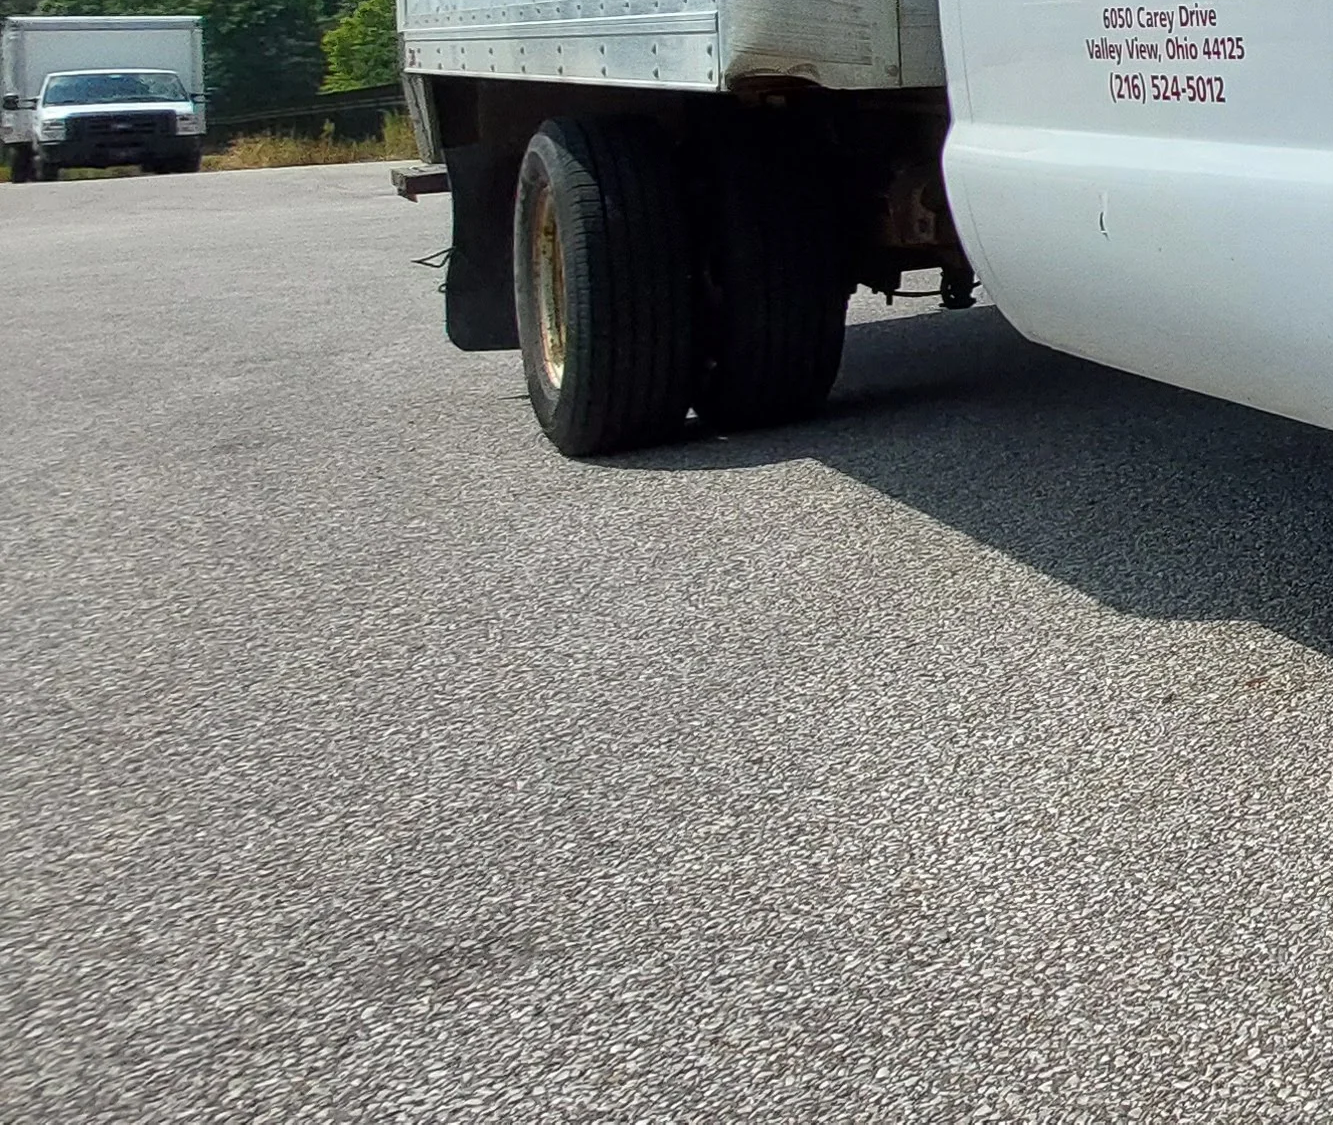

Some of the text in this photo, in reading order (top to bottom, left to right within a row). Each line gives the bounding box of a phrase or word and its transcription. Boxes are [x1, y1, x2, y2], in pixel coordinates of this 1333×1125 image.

[1103, 3, 1217, 34] 6050 Carey Drive
[1085, 36, 1245, 65] Valley View, Ohio 44125
[1109, 72, 1226, 104] (216) 524-5012
